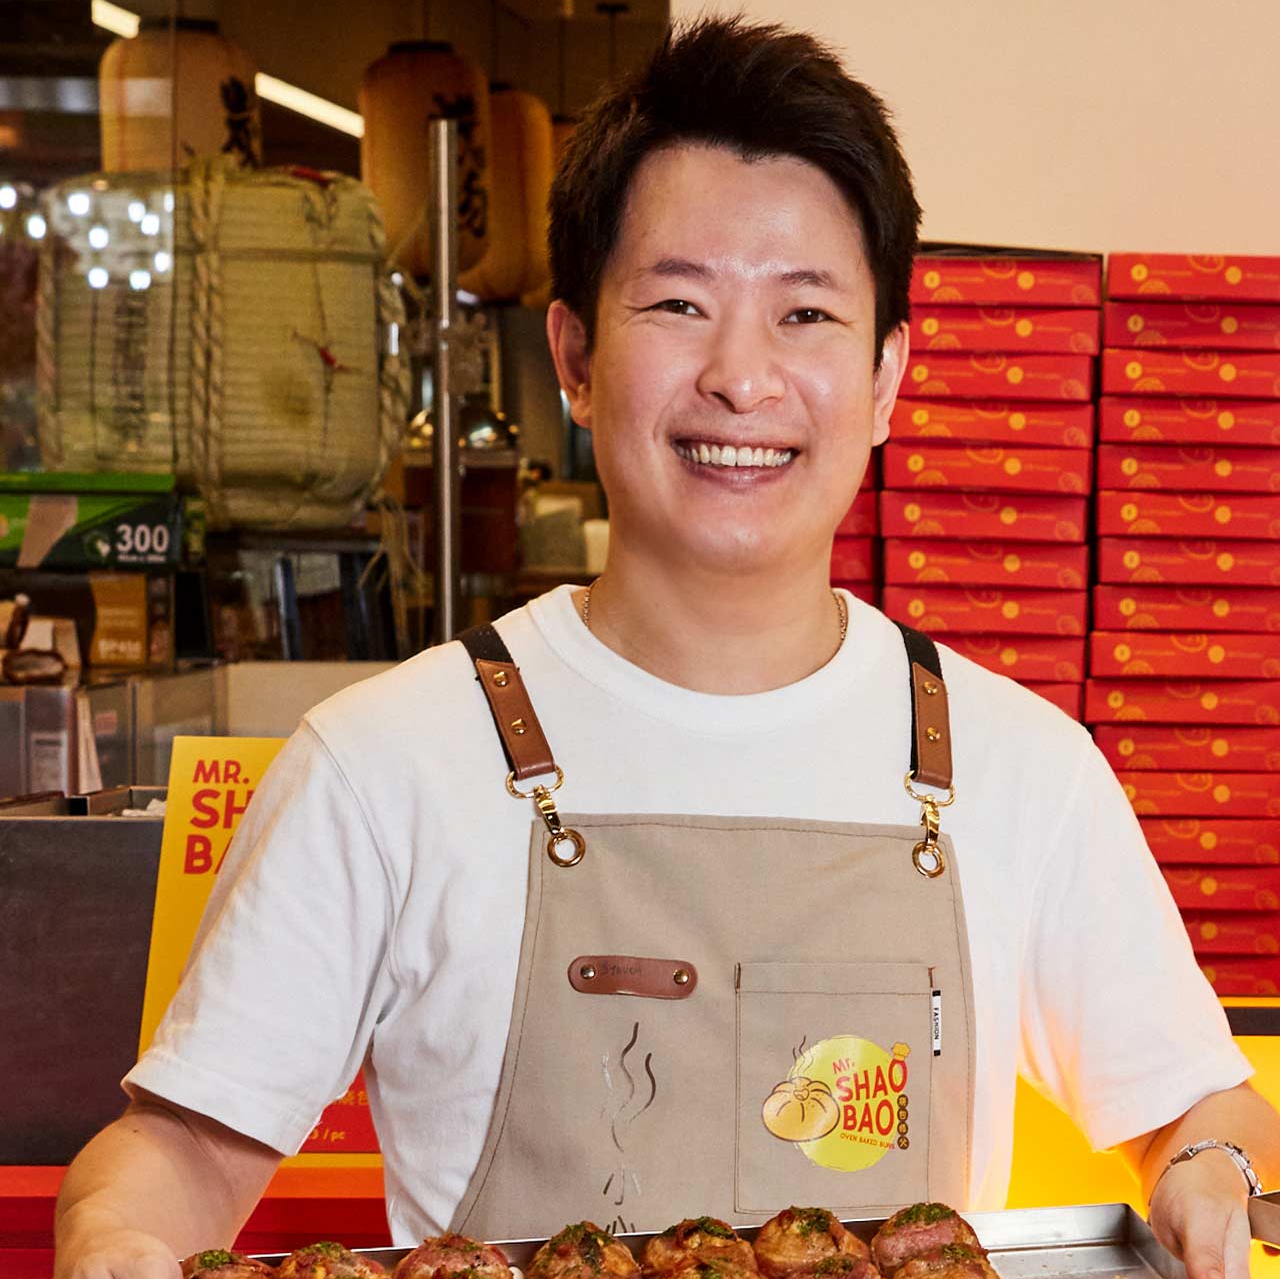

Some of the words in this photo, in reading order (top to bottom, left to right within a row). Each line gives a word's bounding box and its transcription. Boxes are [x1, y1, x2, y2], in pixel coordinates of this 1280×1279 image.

[116, 524, 170, 553] 300
[192, 759, 251, 785] MR.
[189, 788, 255, 830] SH
[835, 1058, 908, 1103] SHAO
[842, 1098, 895, 1137] BAO
